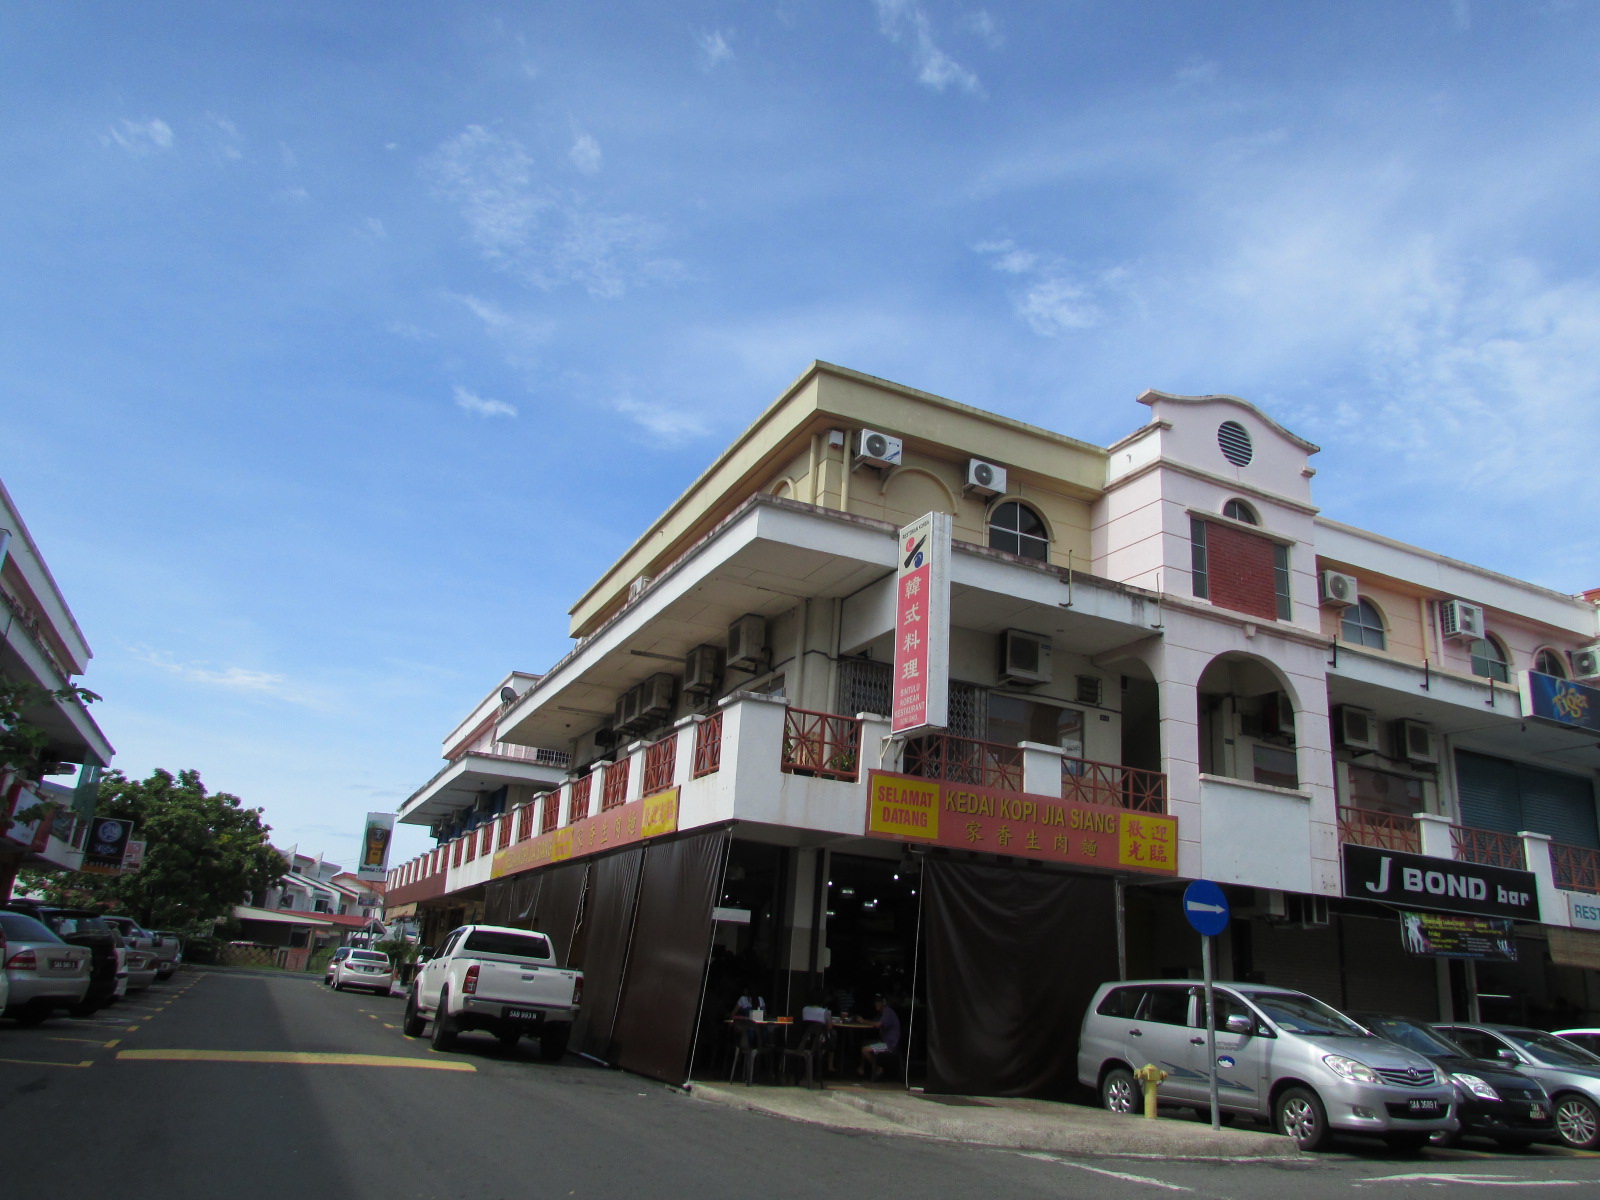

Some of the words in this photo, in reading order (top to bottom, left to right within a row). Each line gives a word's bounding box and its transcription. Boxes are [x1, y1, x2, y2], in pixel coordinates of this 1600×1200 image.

[902, 525, 918, 540] RESTORAN
[902, 576, 922, 680] 韓式料理
[899, 693, 920, 708] KOREAN
[900, 683, 921, 697] BINTULU
[894, 701, 926, 719] RESTAURANT
[1552, 687, 1589, 718] Tiger
[878, 785, 934, 809] SELAMAT
[882, 807, 928, 828] DATANG
[945, 790, 995, 817] KEDAI
[1001, 799, 1038, 824] KOPI
[1041, 805, 1066, 828] JIA
[1070, 808, 1117, 834] SIANG
[964, 819, 1098, 858] 家香生肉麵
[1127, 818, 1169, 844] 歡迎
[1127, 840, 1168, 863] 光臨
[1365, 856, 1392, 893] J
[1402, 867, 1487, 900] BOND
[1496, 885, 1530, 907] bar
